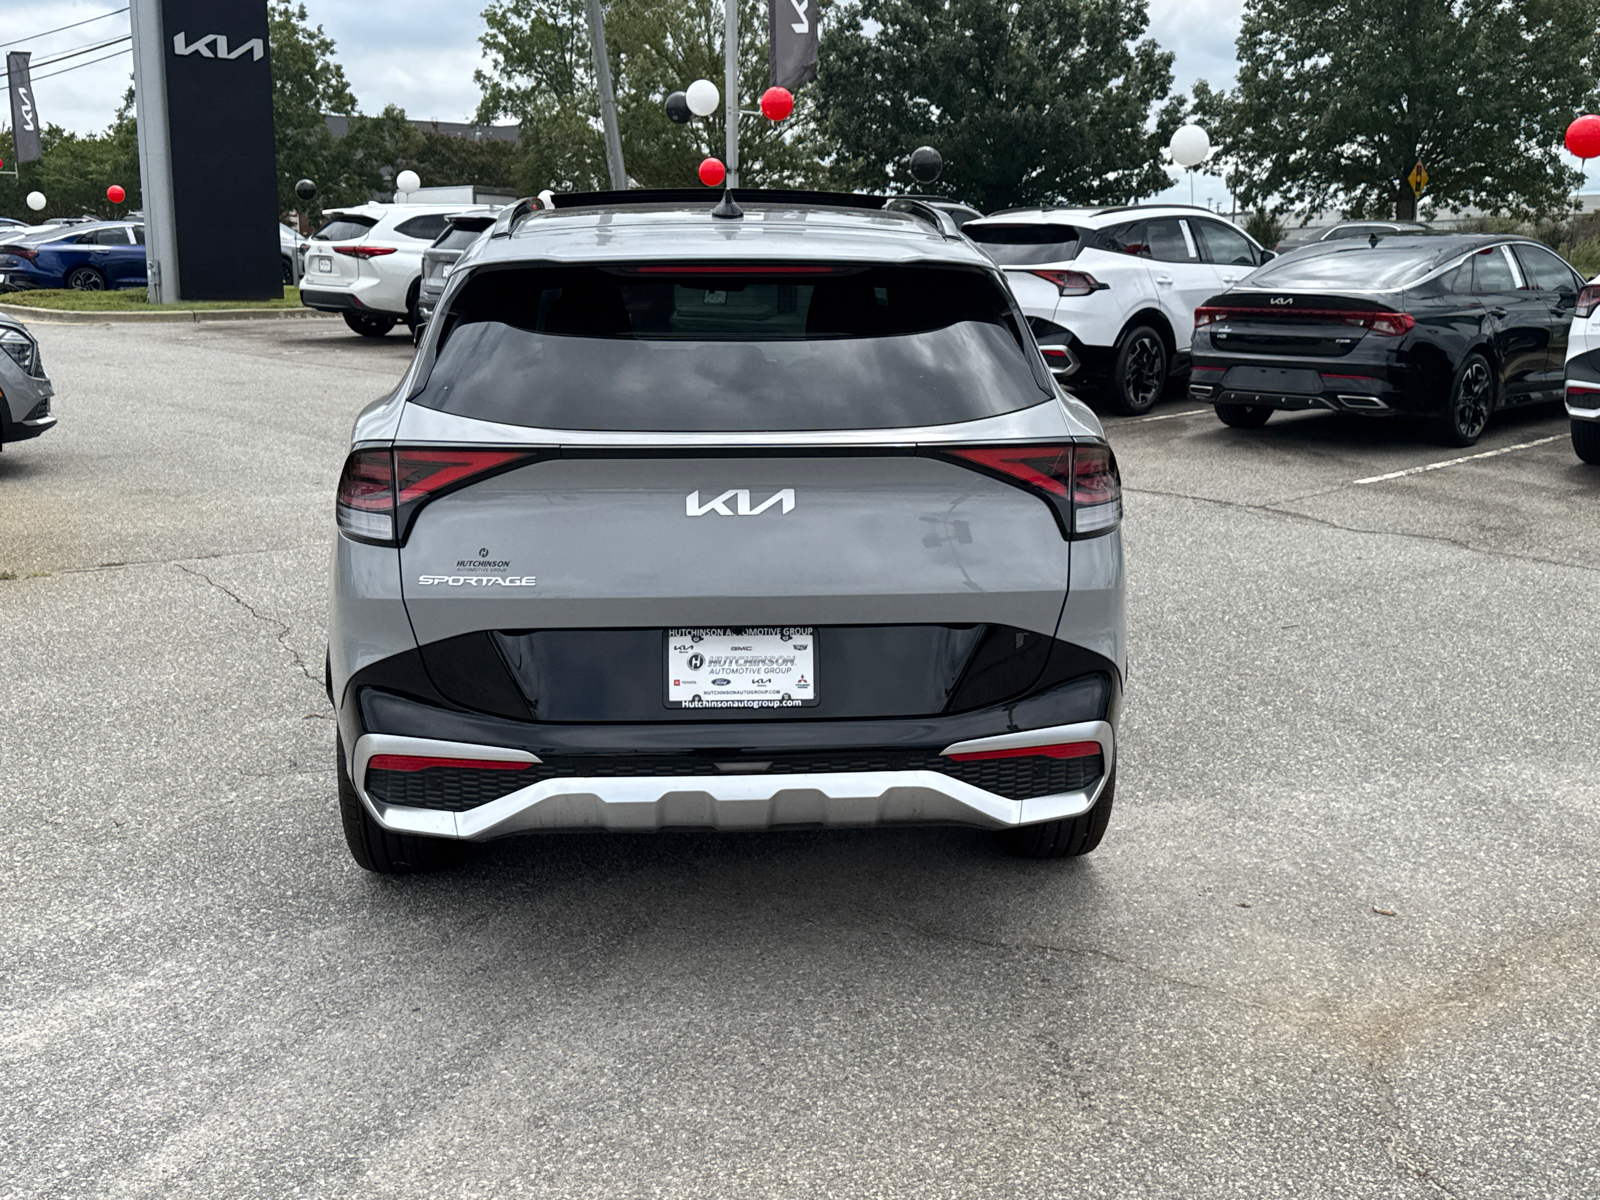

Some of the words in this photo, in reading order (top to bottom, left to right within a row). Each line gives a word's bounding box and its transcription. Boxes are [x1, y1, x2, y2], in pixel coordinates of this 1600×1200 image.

[173, 31, 264, 62] KIA
[18, 87, 35, 131] KIA
[1270, 297, 1293, 305] KIA
[685, 488, 796, 517] KIA
[456, 560, 510, 568] HUTCHINSON
[418, 574, 537, 586] SPORTAGE
[668, 628, 724, 637] HUTCHINSON
[725, 627, 781, 636] AOMOTIVE
[783, 627, 813, 636] GROUP
[707, 655, 796, 668] HUTCHINSON
[708, 667, 762, 675] AUTOMOTIVE
[681, 699, 802, 709] Hutchinsonautogroup.com
